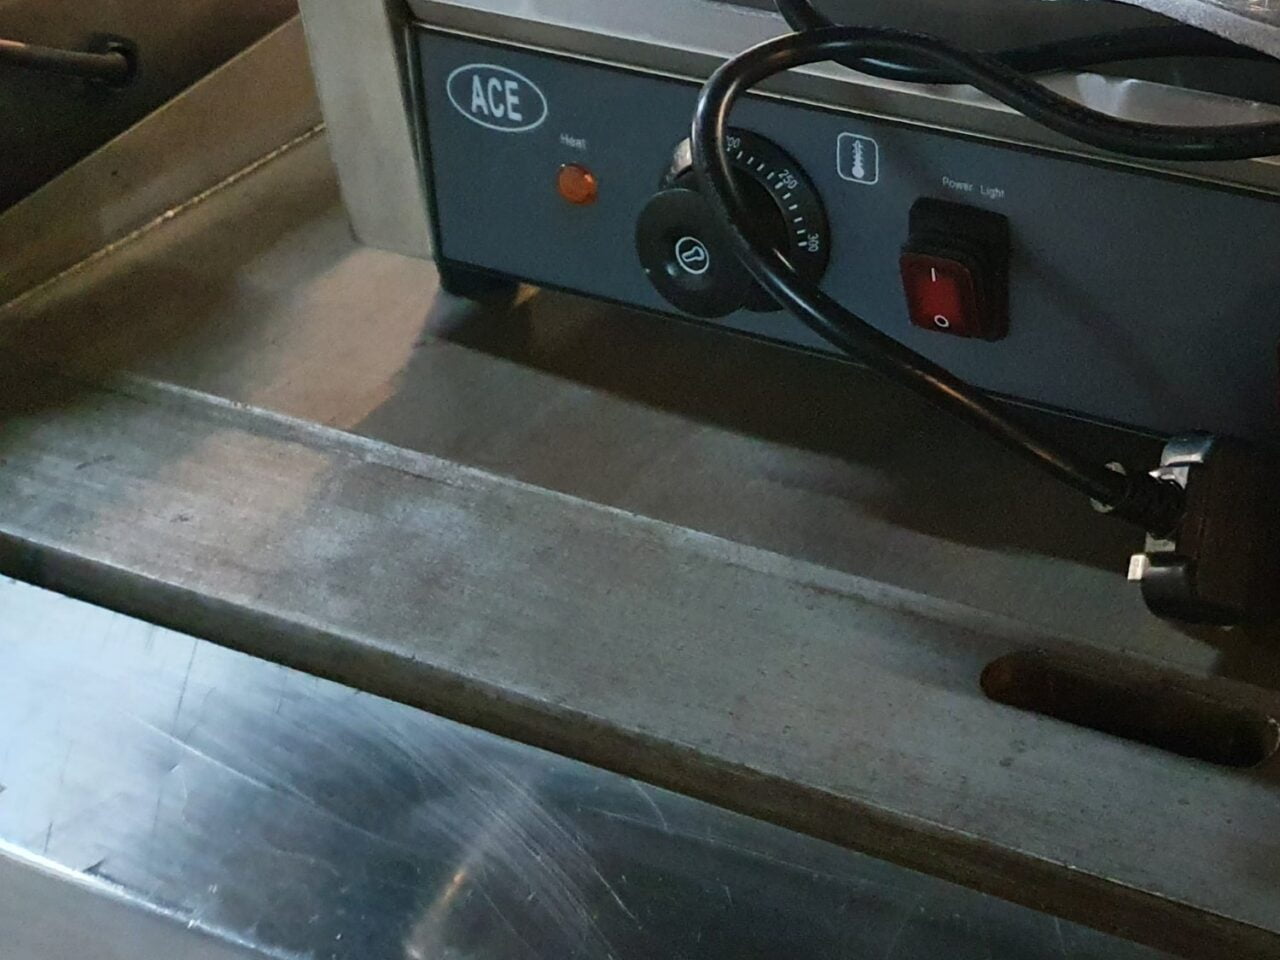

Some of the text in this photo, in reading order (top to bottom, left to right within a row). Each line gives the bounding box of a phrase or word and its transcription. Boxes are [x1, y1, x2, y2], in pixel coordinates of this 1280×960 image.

[471, 74, 523, 122] ACE
[778, 168, 798, 190] 250
[942, 175, 1005, 200] Power Light
[807, 233, 819, 253] 300
